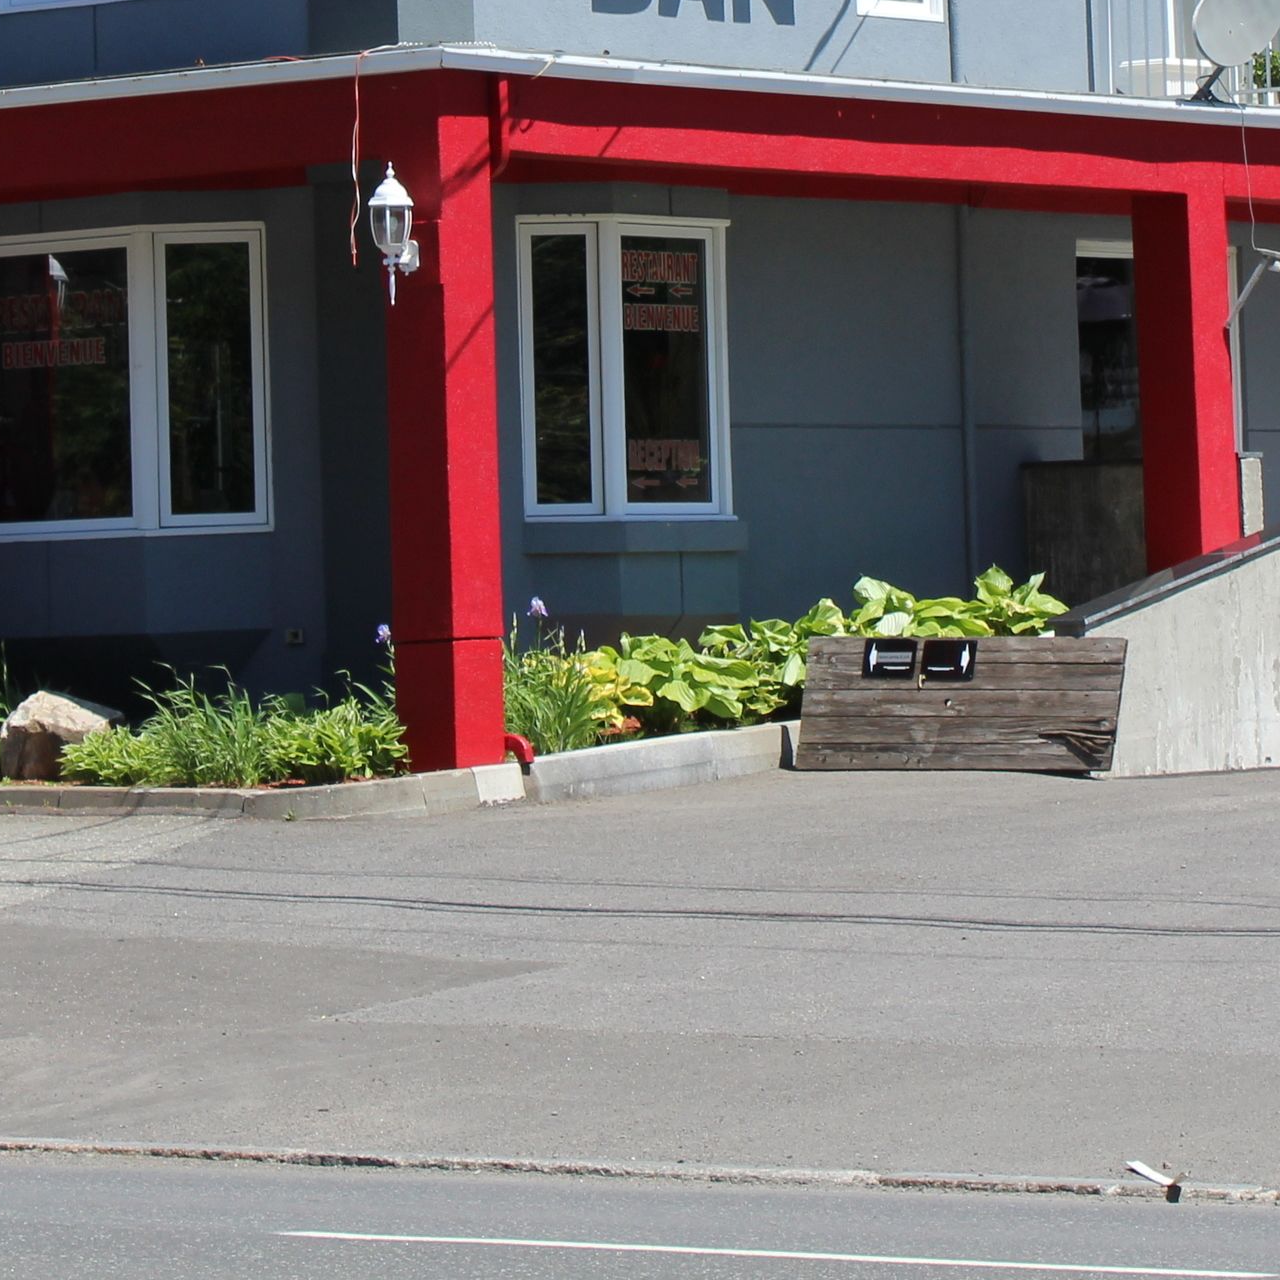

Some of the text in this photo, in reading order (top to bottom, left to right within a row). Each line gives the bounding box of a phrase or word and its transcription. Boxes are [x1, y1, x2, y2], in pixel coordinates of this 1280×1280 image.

[622, 249, 698, 284] RESTAURANT
[624, 303, 699, 332] BIENVENUE
[1, 336, 106, 370] BIENVENUE
